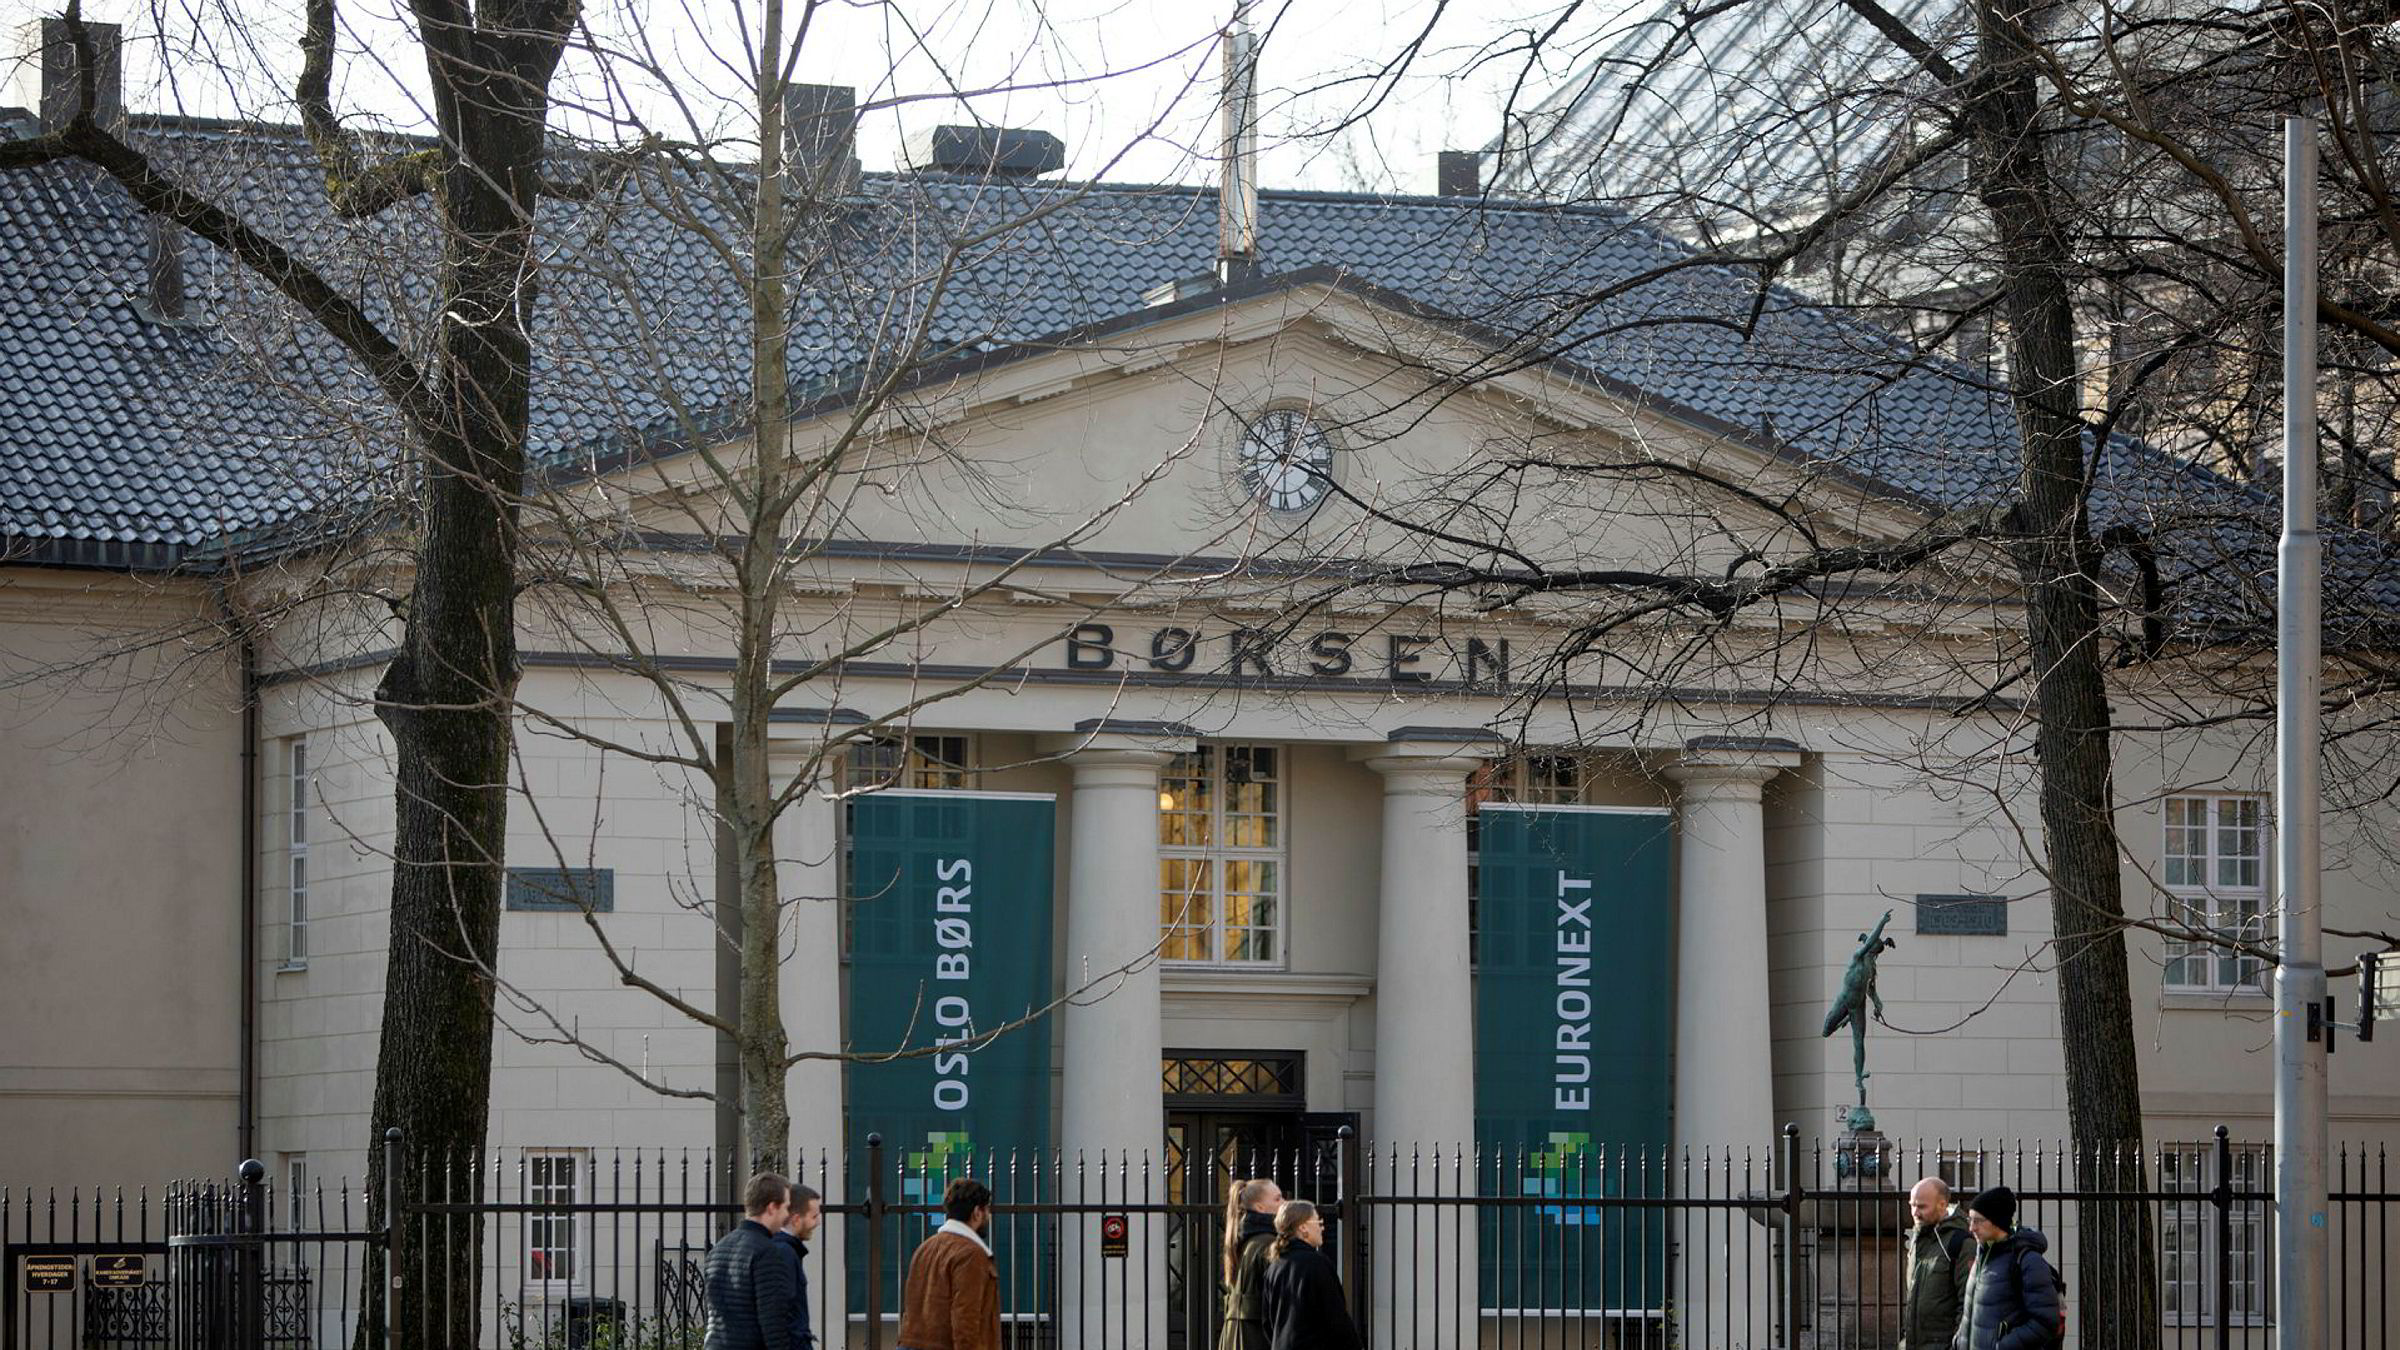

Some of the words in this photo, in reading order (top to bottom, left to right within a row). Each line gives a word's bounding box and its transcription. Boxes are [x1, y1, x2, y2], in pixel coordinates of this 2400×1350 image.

[1067, 622, 1509, 684] BØRSEN
[933, 858, 973, 980] BØRS
[1555, 869, 1592, 1111] EURONEXT
[933, 995, 969, 1111] OSLO
[1839, 1107, 1847, 1120] 2
